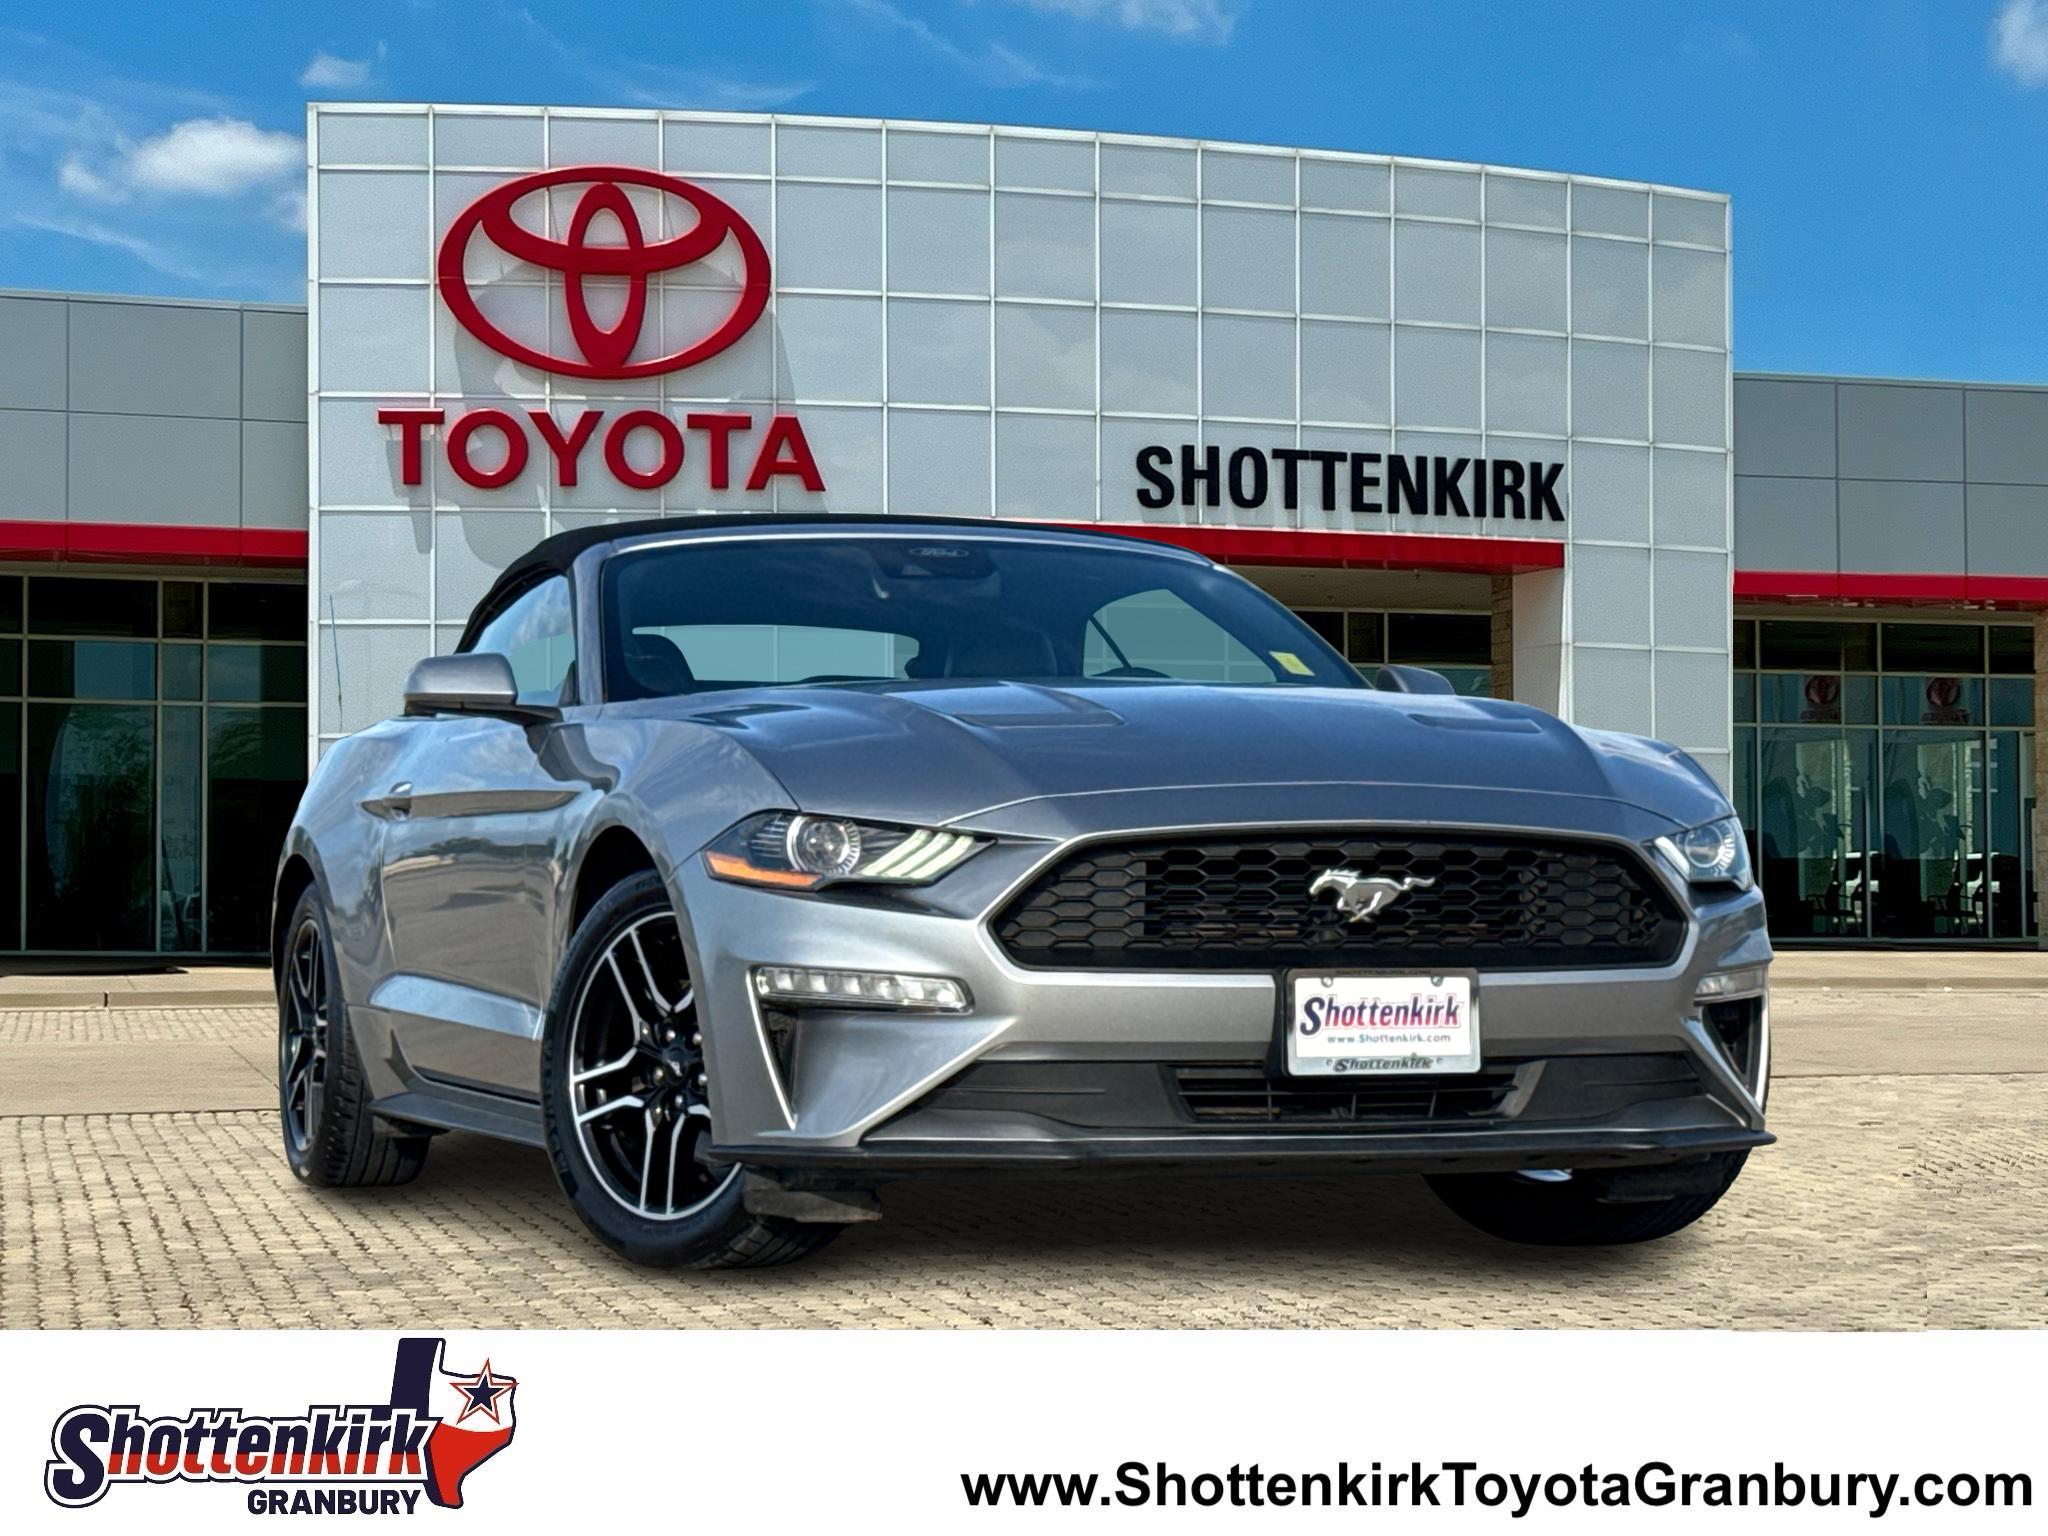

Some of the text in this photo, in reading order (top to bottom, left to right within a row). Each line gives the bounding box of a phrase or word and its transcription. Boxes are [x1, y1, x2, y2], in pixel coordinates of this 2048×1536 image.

[377, 407, 827, 492] TOYOTA
[1136, 444, 1566, 522] SHOTTENKIRK
[1299, 995, 1461, 1036] Shottenkirk
[1327, 1033, 1451, 1044] www.Shottenkirk.com
